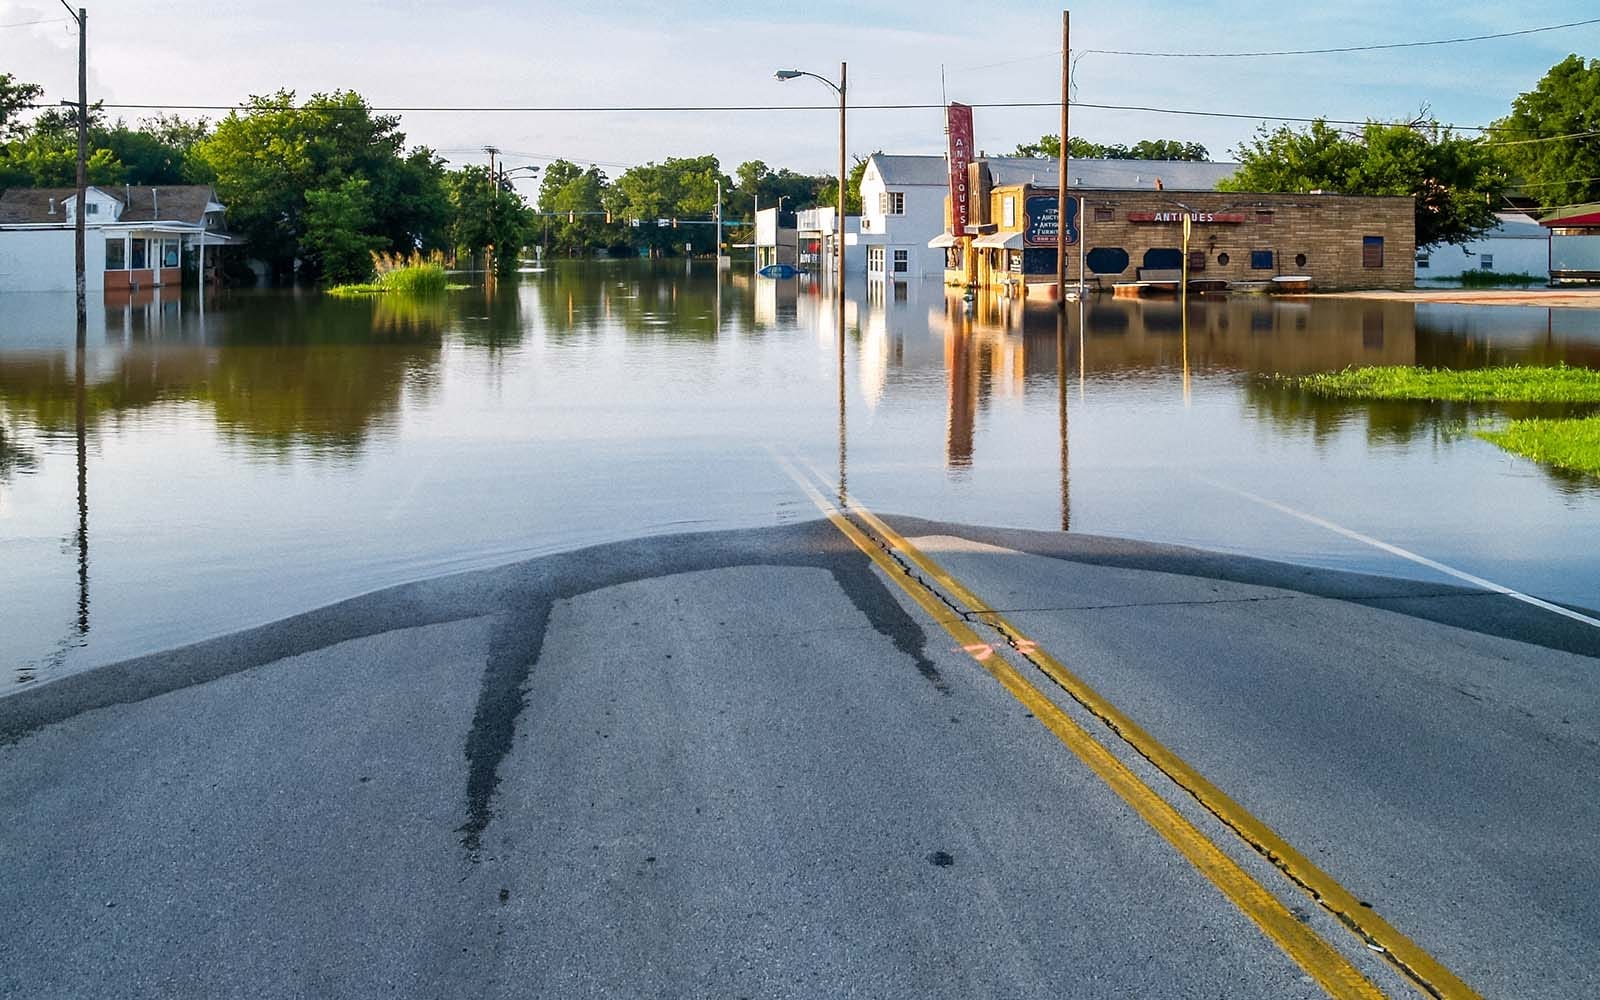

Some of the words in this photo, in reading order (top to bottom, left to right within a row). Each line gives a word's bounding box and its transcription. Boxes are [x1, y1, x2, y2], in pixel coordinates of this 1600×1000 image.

[956, 138, 966, 224] ANTIQUES
[1154, 212, 1214, 222] ANTIUES
[1037, 228, 1071, 236] FURNITE
